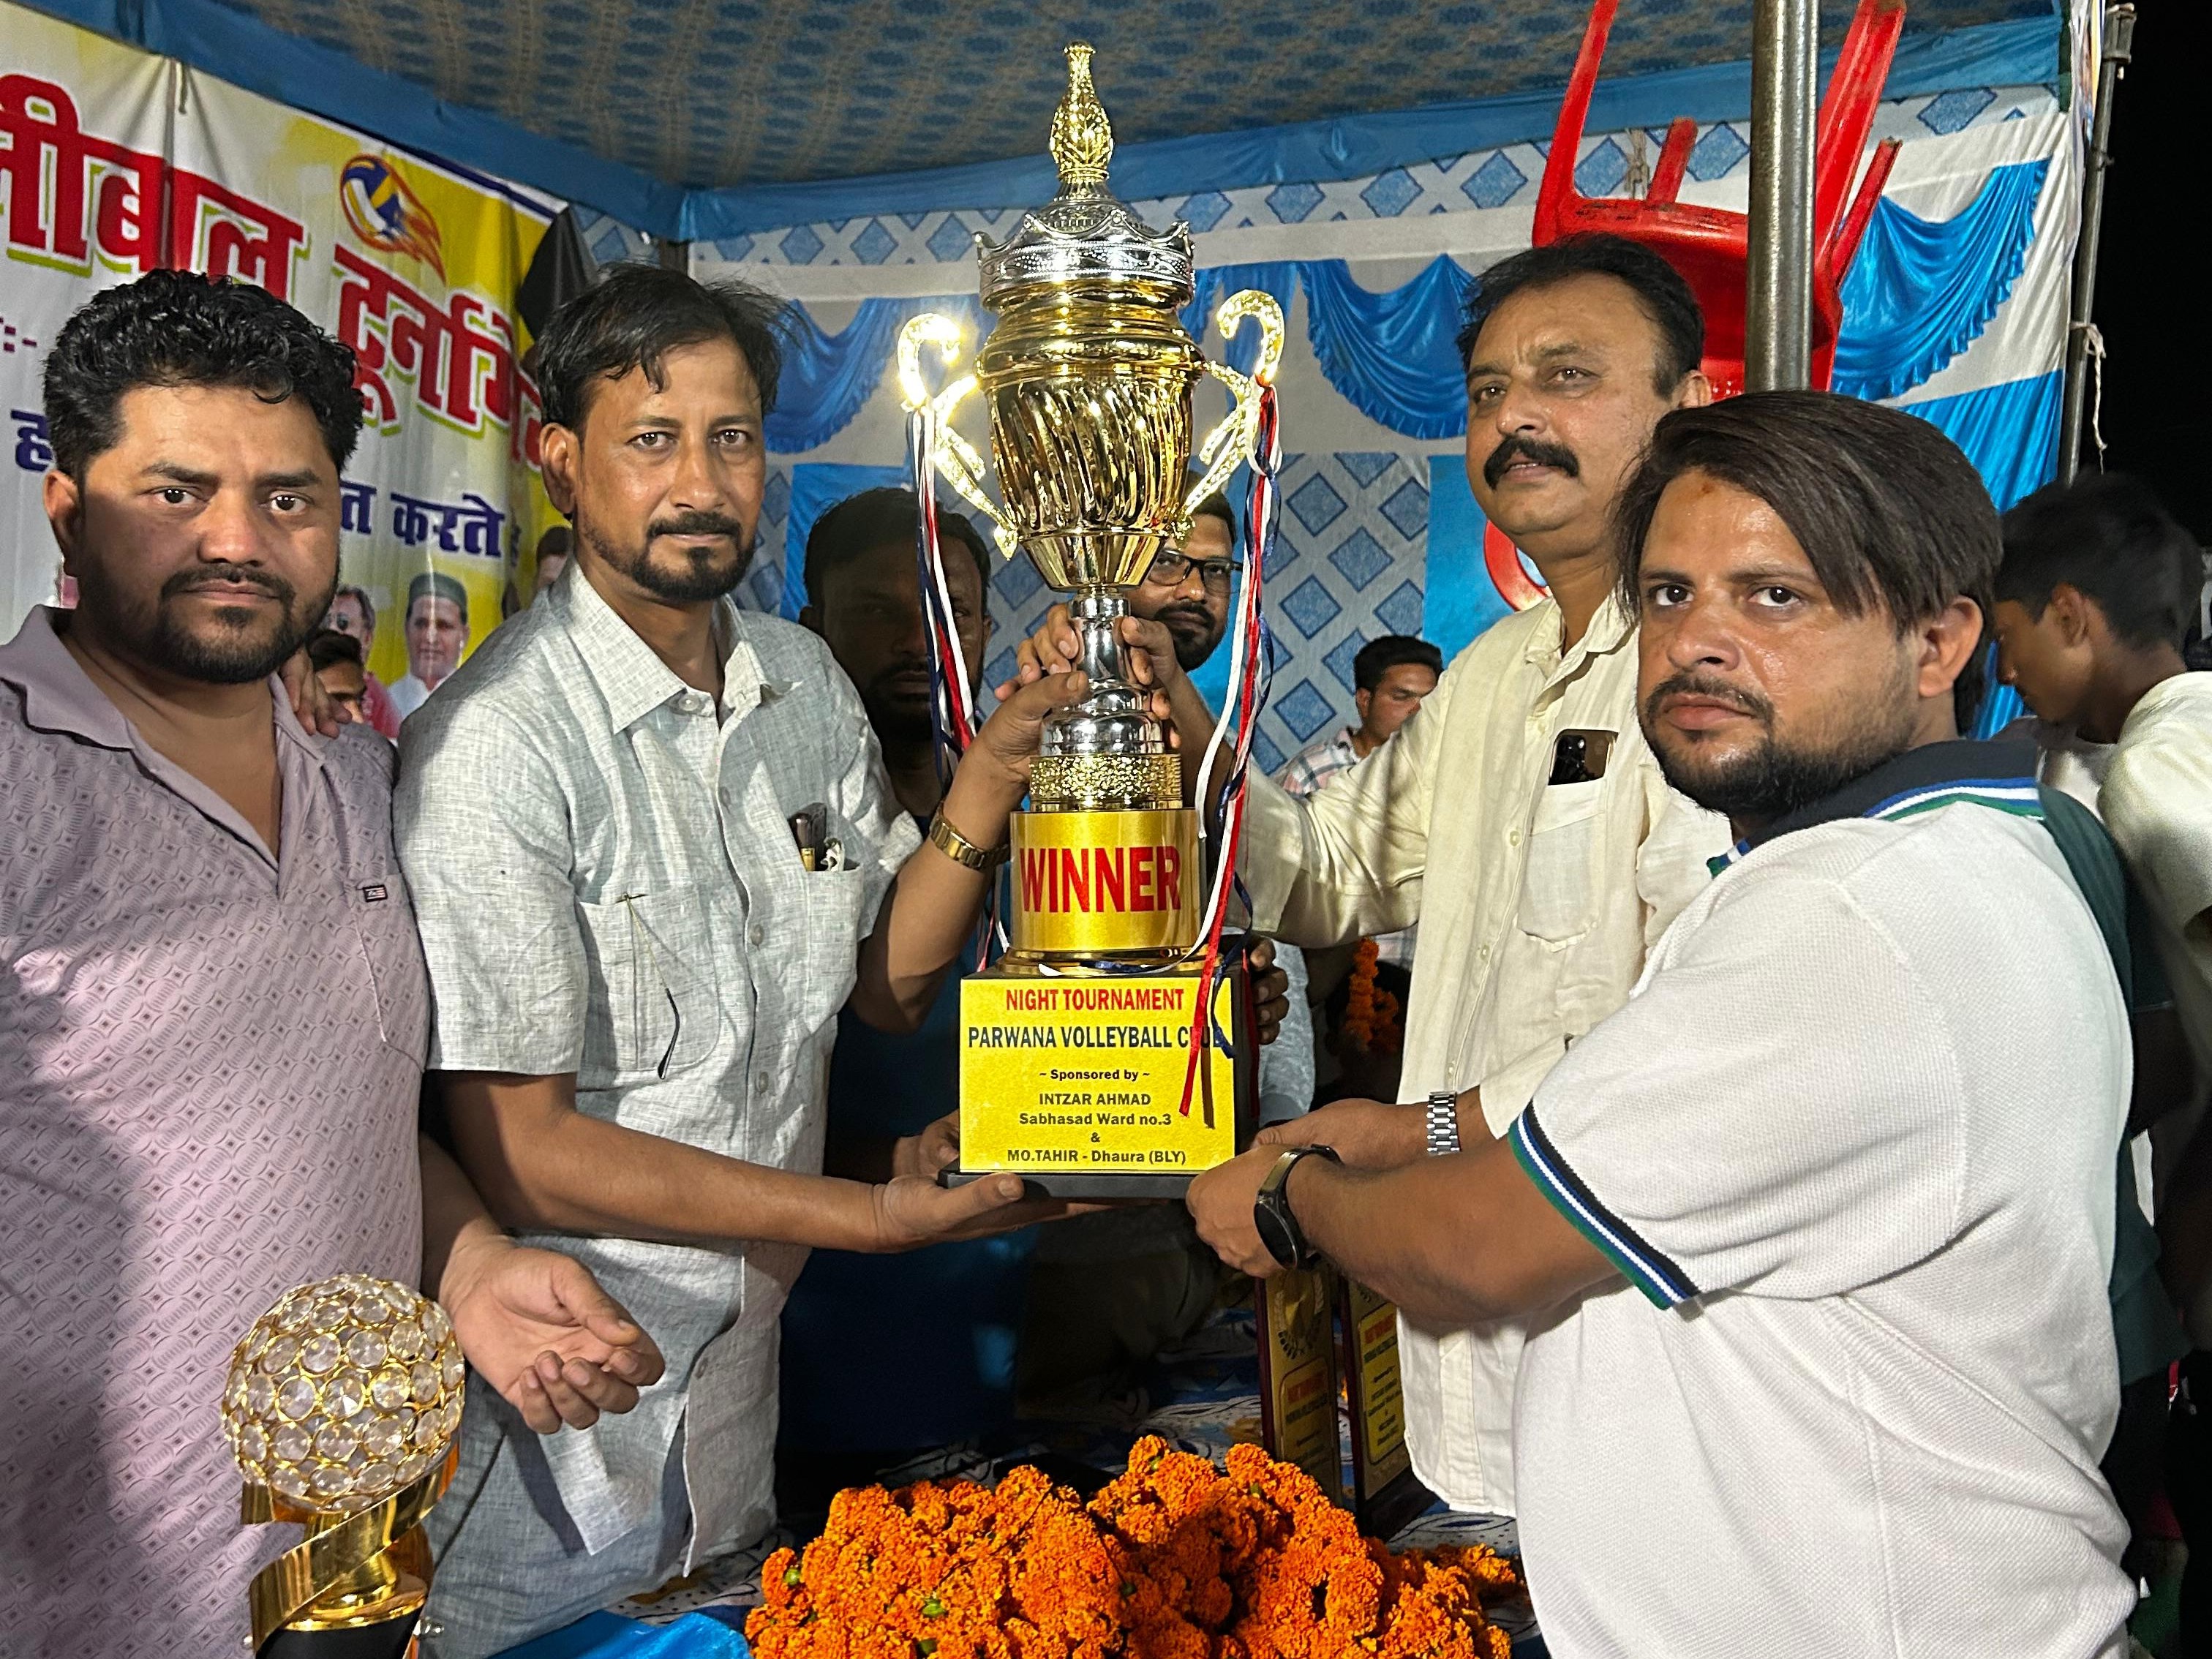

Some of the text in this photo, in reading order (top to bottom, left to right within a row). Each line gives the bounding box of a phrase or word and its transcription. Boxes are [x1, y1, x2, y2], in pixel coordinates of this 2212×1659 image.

[391, 492, 505, 557] करते
[1019, 846, 1181, 913] WINNER
[1006, 988, 1184, 1011] NIGHT TOURNAMENT
[968, 1026, 1055, 1048] PARWANA
[1061, 1026, 1173, 1048] VOLLEYBALL
[1050, 1069, 1120, 1082] Sponsored
[1124, 1069, 1139, 1082] by
[1039, 1093, 1151, 1105] INTZAR AHMAD
[1019, 1113, 1172, 1126] Sabhasad Ward no.3
[1090, 1132, 1101, 1143] &
[1007, 1149, 1079, 1162] MO.TAHIR
[1091, 1150, 1146, 1162] Dhaura
[1148, 1150, 1186, 1165] (BLY)
